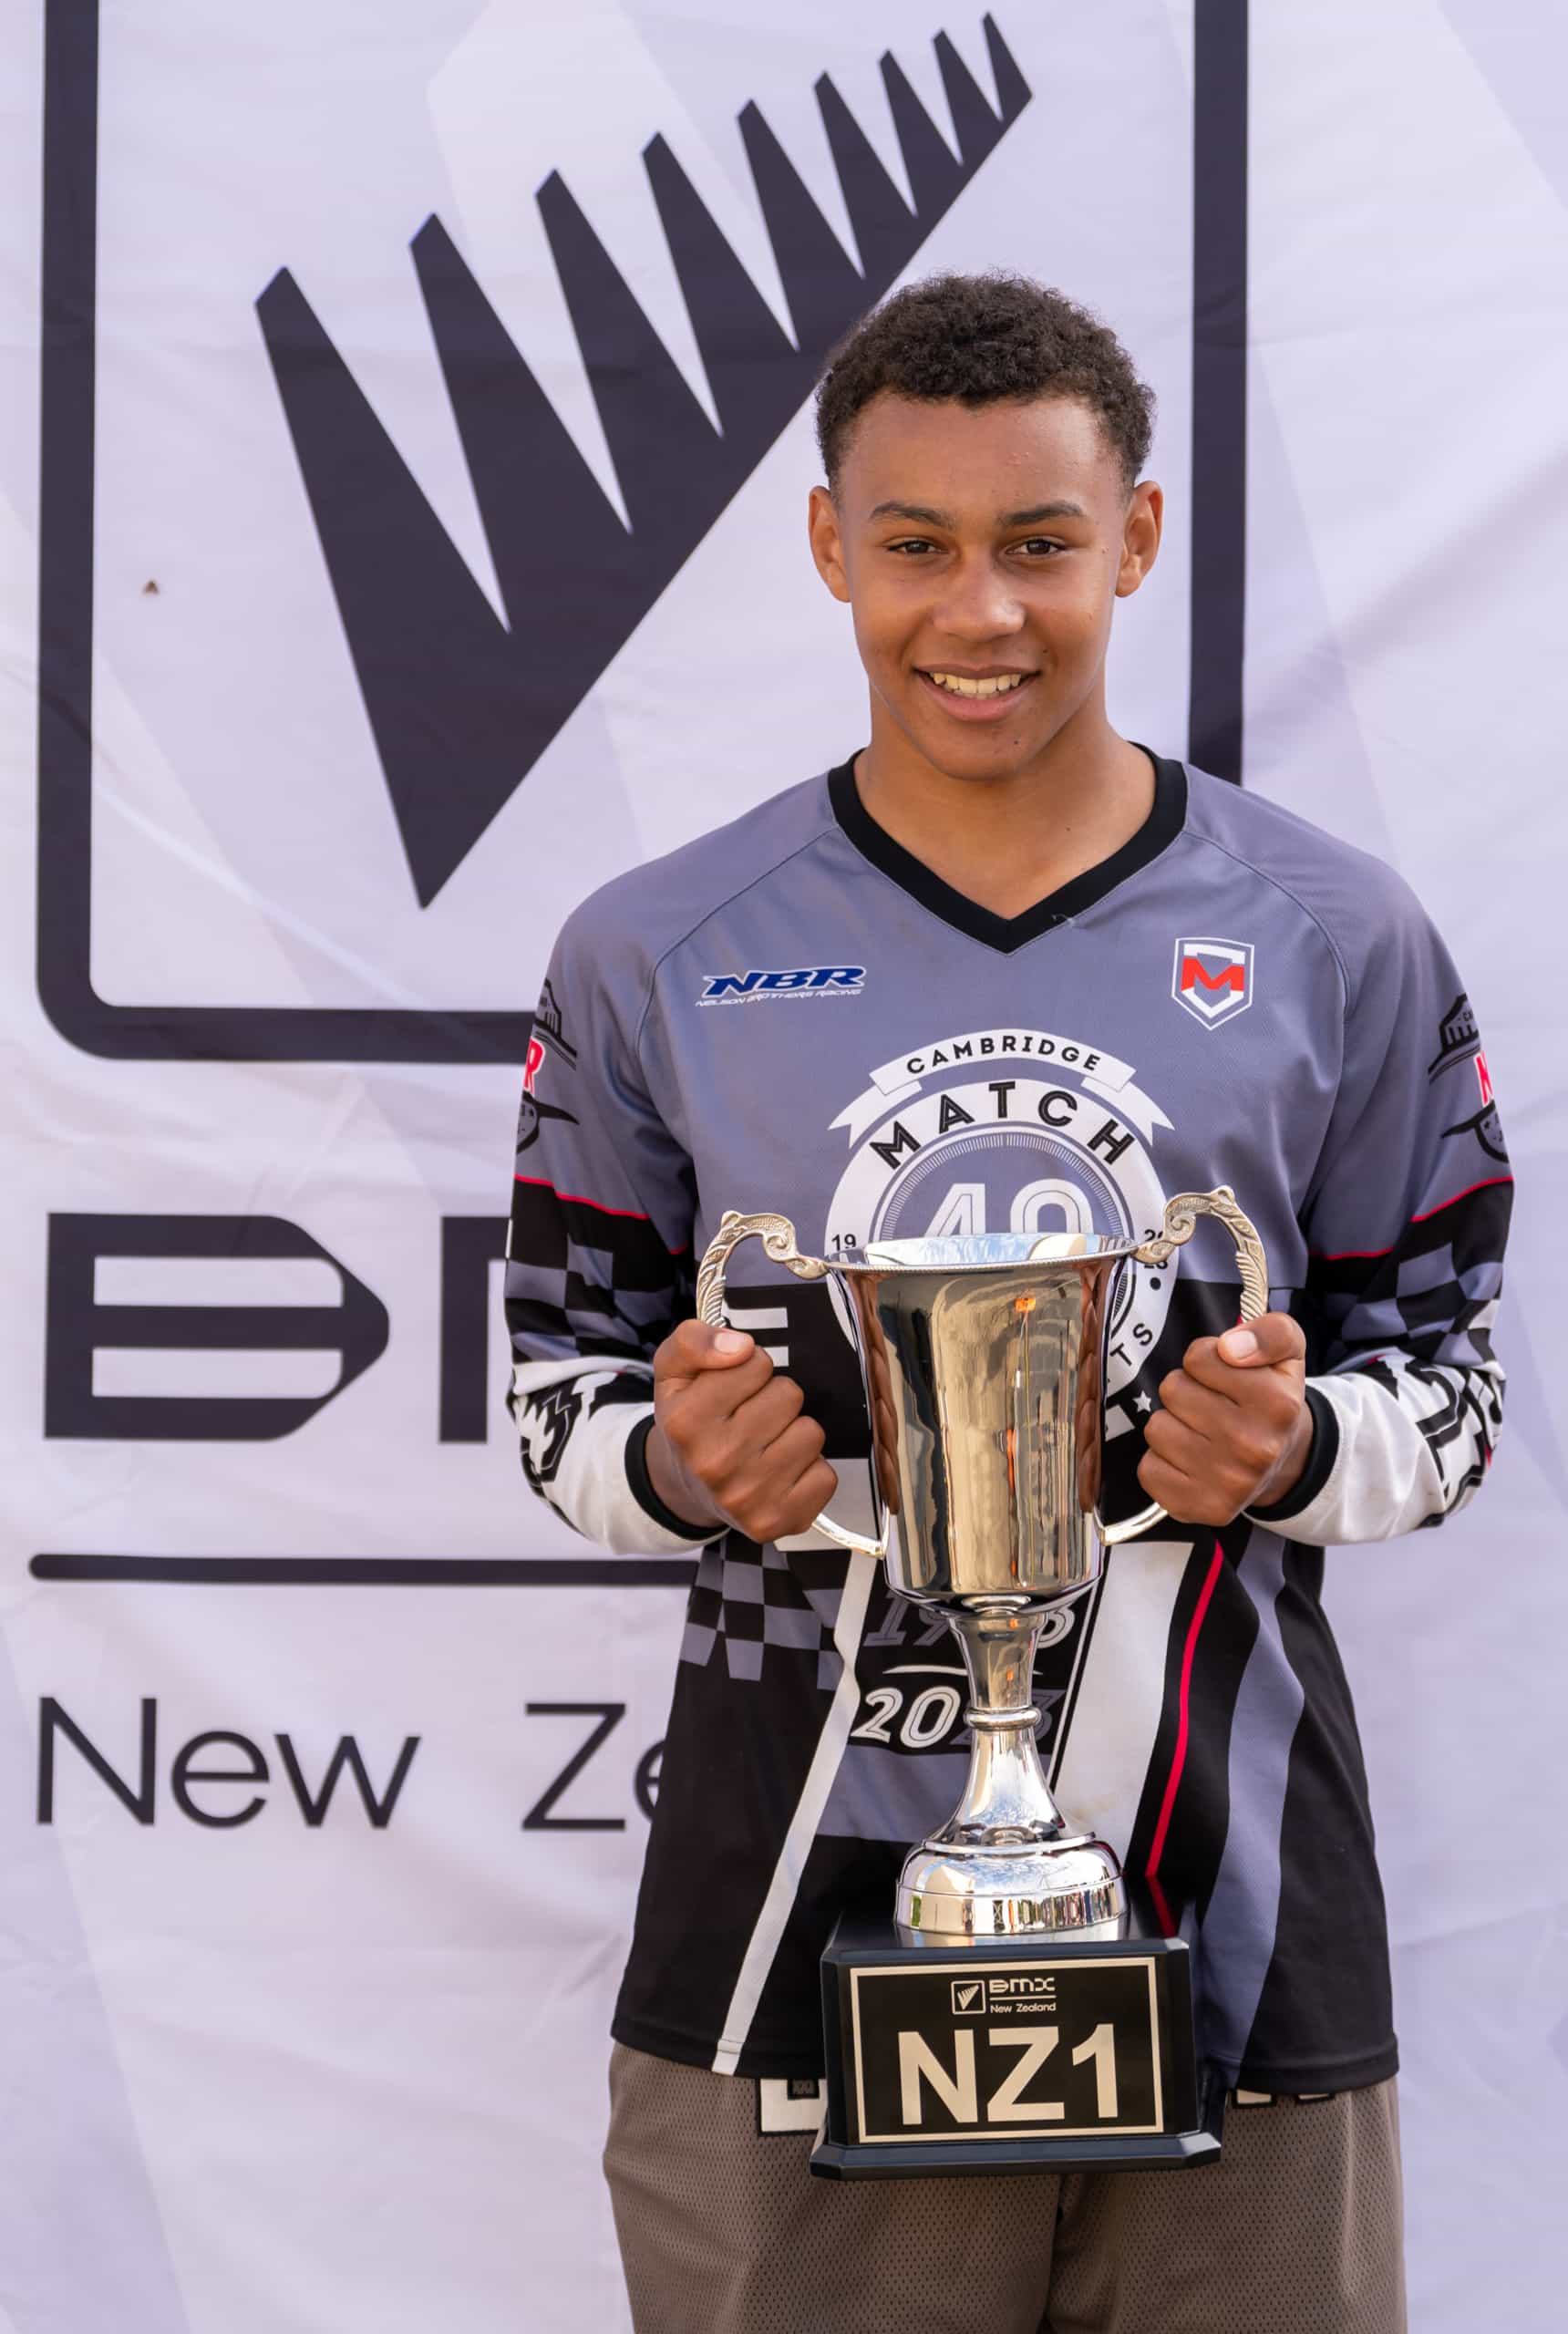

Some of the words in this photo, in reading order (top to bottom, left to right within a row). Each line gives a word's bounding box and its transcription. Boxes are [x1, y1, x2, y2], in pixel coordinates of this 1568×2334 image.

[696, 997, 746, 1007] NELSON
[814, 987, 862, 997] RACING
[702, 966, 867, 997] NBR
[906, 1034, 1101, 1075] CAMBRIDGE
[869, 1080, 1135, 1171] MATCH
[36, 1696, 422, 1830] New
[990, 2004, 1013, 2014] New
[1016, 2002, 1057, 2013] Zealand
[898, 2023, 1119, 2126] NZ1
